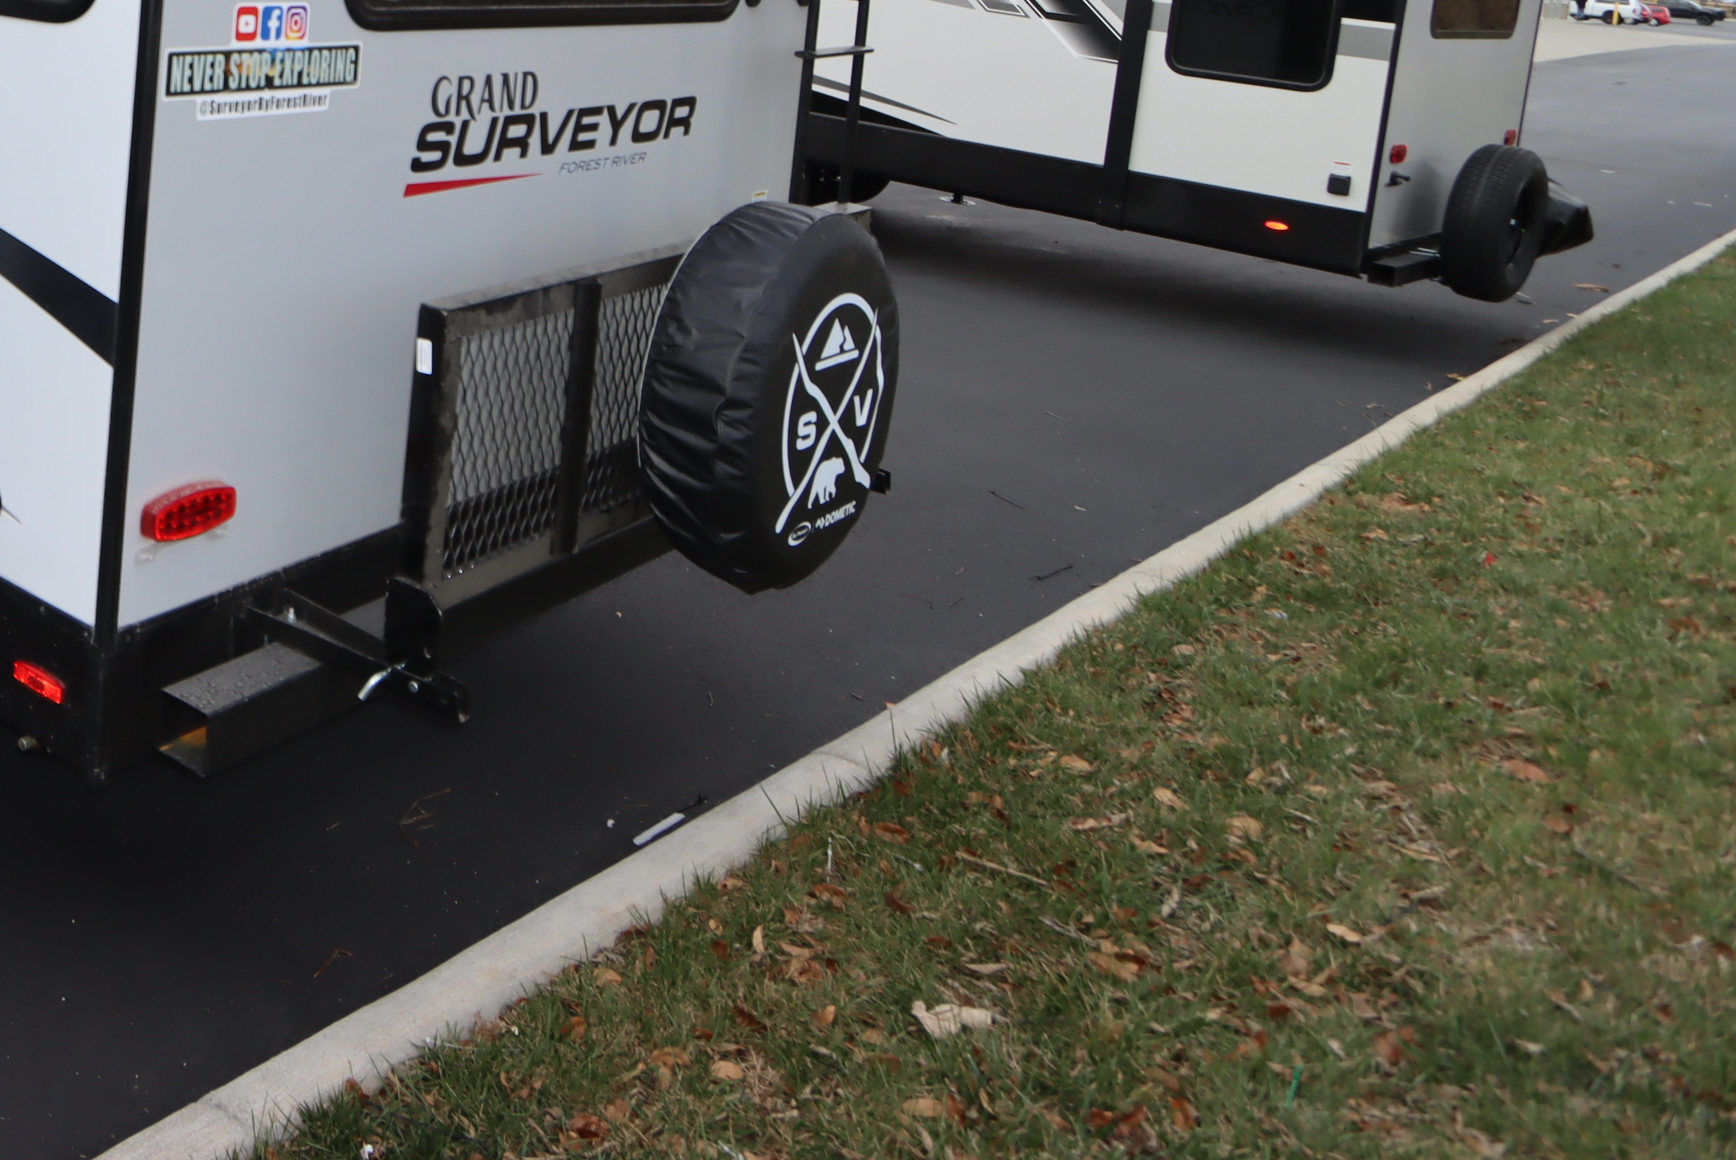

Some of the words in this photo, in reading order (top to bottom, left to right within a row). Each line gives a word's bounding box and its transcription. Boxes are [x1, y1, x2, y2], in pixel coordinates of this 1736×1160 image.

[169, 54, 227, 93] NEVER
[227, 51, 273, 91] STOP
[273, 47, 357, 88] EXPLORING
[430, 71, 540, 121] GRAND
[410, 95, 698, 174] SURVEYOR
[558, 157, 610, 175] FOREST
[611, 151, 648, 167] RIVER
[824, 500, 857, 527] DOMETIC
